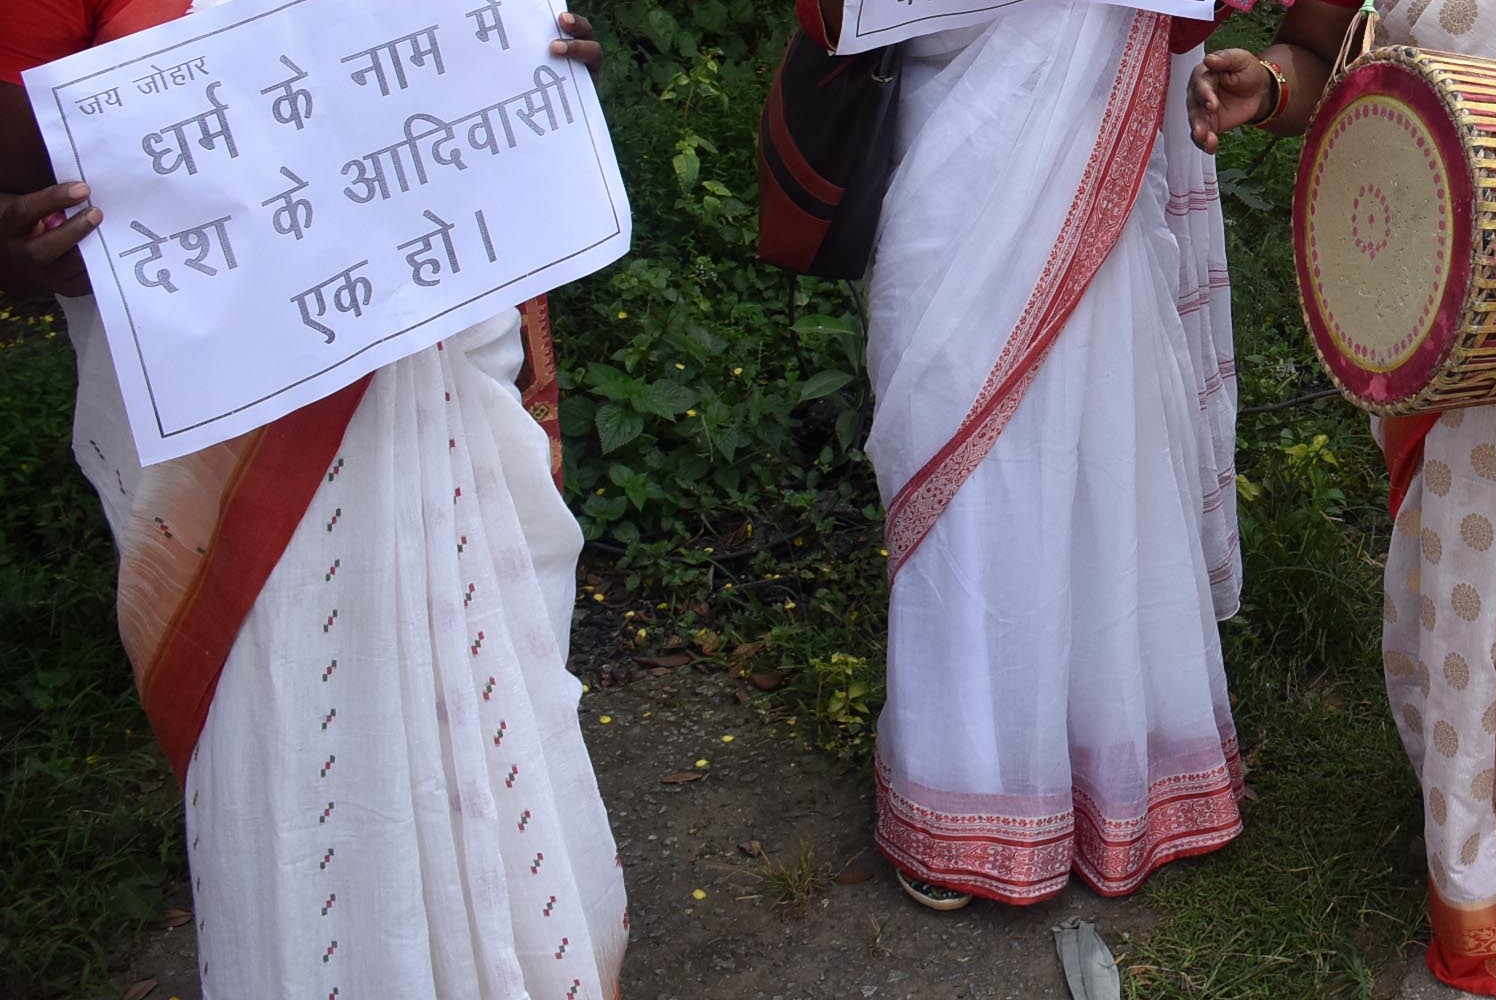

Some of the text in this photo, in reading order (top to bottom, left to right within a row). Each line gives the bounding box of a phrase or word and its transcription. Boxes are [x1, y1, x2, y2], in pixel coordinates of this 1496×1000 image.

[75, 56, 210, 117] जय जोहार
[141, 81, 240, 176] धर्म
[260, 54, 314, 130] के
[340, 24, 446, 98] नाम
[119, 64, 575, 295] देश के आदिवासी
[290, 259, 373, 344] एक
